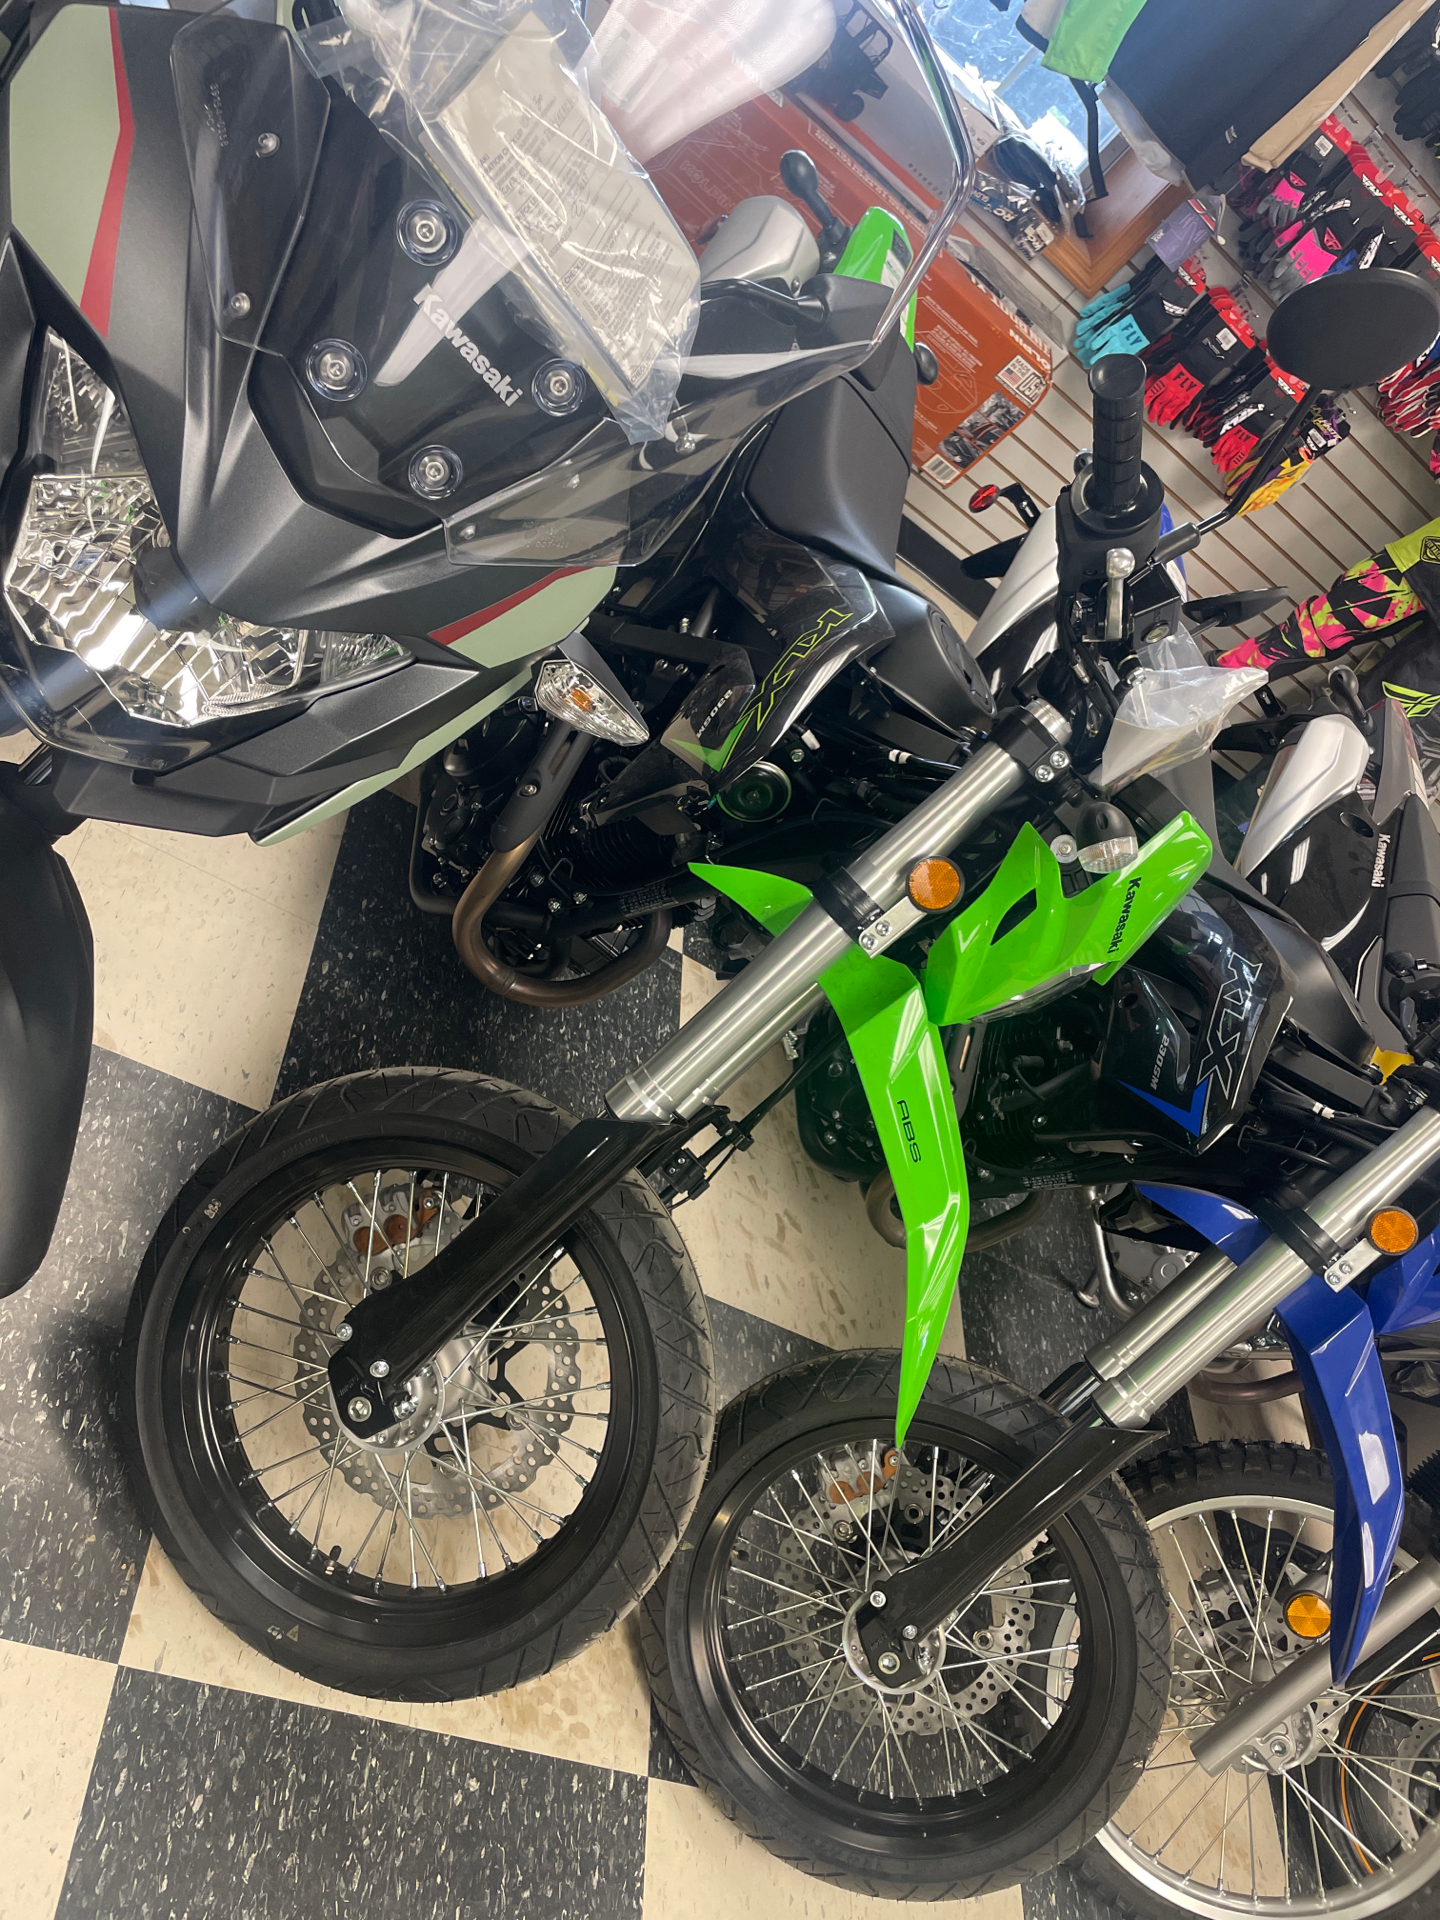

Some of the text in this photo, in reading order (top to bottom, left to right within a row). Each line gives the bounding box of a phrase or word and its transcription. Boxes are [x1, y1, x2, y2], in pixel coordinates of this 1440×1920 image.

[679, 158, 735, 213] KOLPIN
[413, 283, 524, 408] Kawasaki
[1119, 321, 1144, 350] FLY
[1013, 357, 1031, 373] MADE
[1015, 366, 1027, 377] THE
[1171, 369, 1198, 394] FLY
[1232, 427, 1251, 445] FLY
[739, 606, 853, 732] KLX
[695, 688, 733, 738] 230SM
[1371, 833, 1391, 888] Kawasaki
[1106, 876, 1142, 954] Kawasaki
[1196, 953, 1264, 1101] KLX
[1149, 1033, 1172, 1091] 230SM
[896, 1099, 922, 1164] ABS
